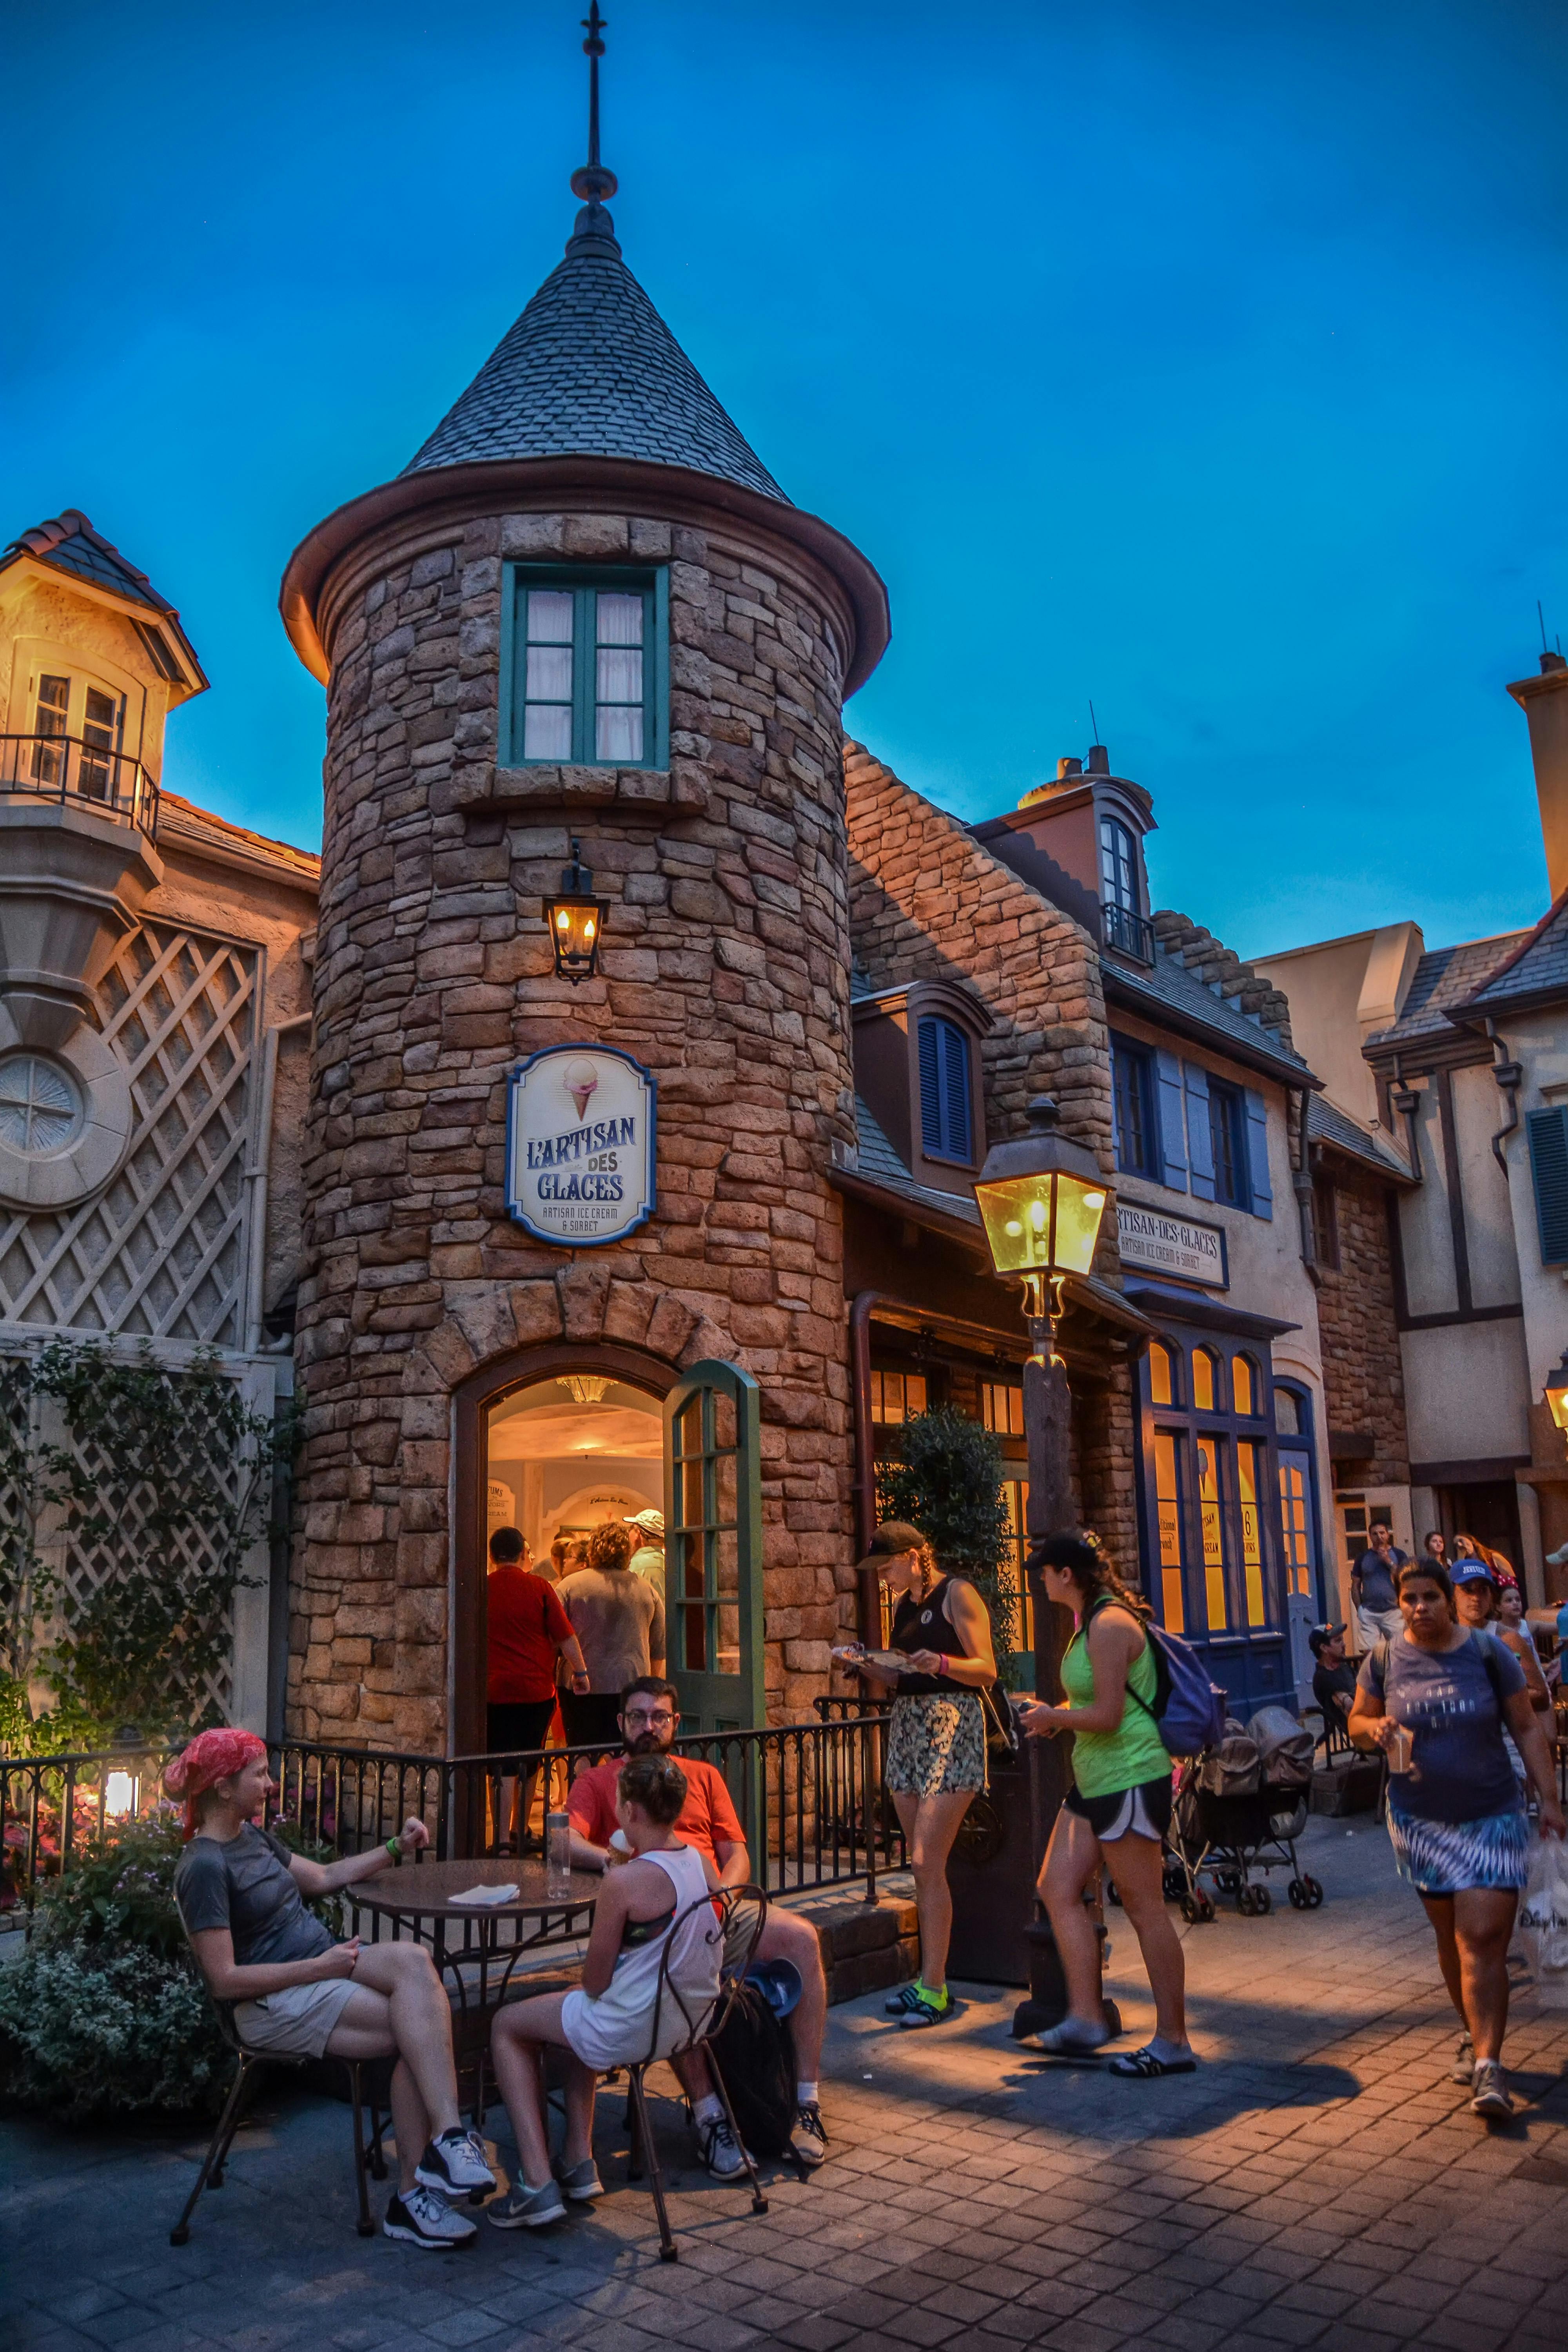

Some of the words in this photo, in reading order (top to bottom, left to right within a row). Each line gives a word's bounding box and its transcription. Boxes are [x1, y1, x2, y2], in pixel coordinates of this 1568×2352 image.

[527, 1117, 635, 1169] L'ARTISAN
[588, 1151, 618, 1172] DES
[537, 1173, 623, 1201] GLACES
[543, 1207, 575, 1218] ARTISAN
[578, 1208, 589, 1218] ICE
[592, 1208, 617, 1219] CREAM
[563, 1220, 567, 1231] &
[570, 1220, 598, 1232] SORBET
[1121, 1236, 1145, 1256] ARTISAN
[1147, 1243, 1155, 1259] ICE
[1156, 1245, 1175, 1263] CREAM
